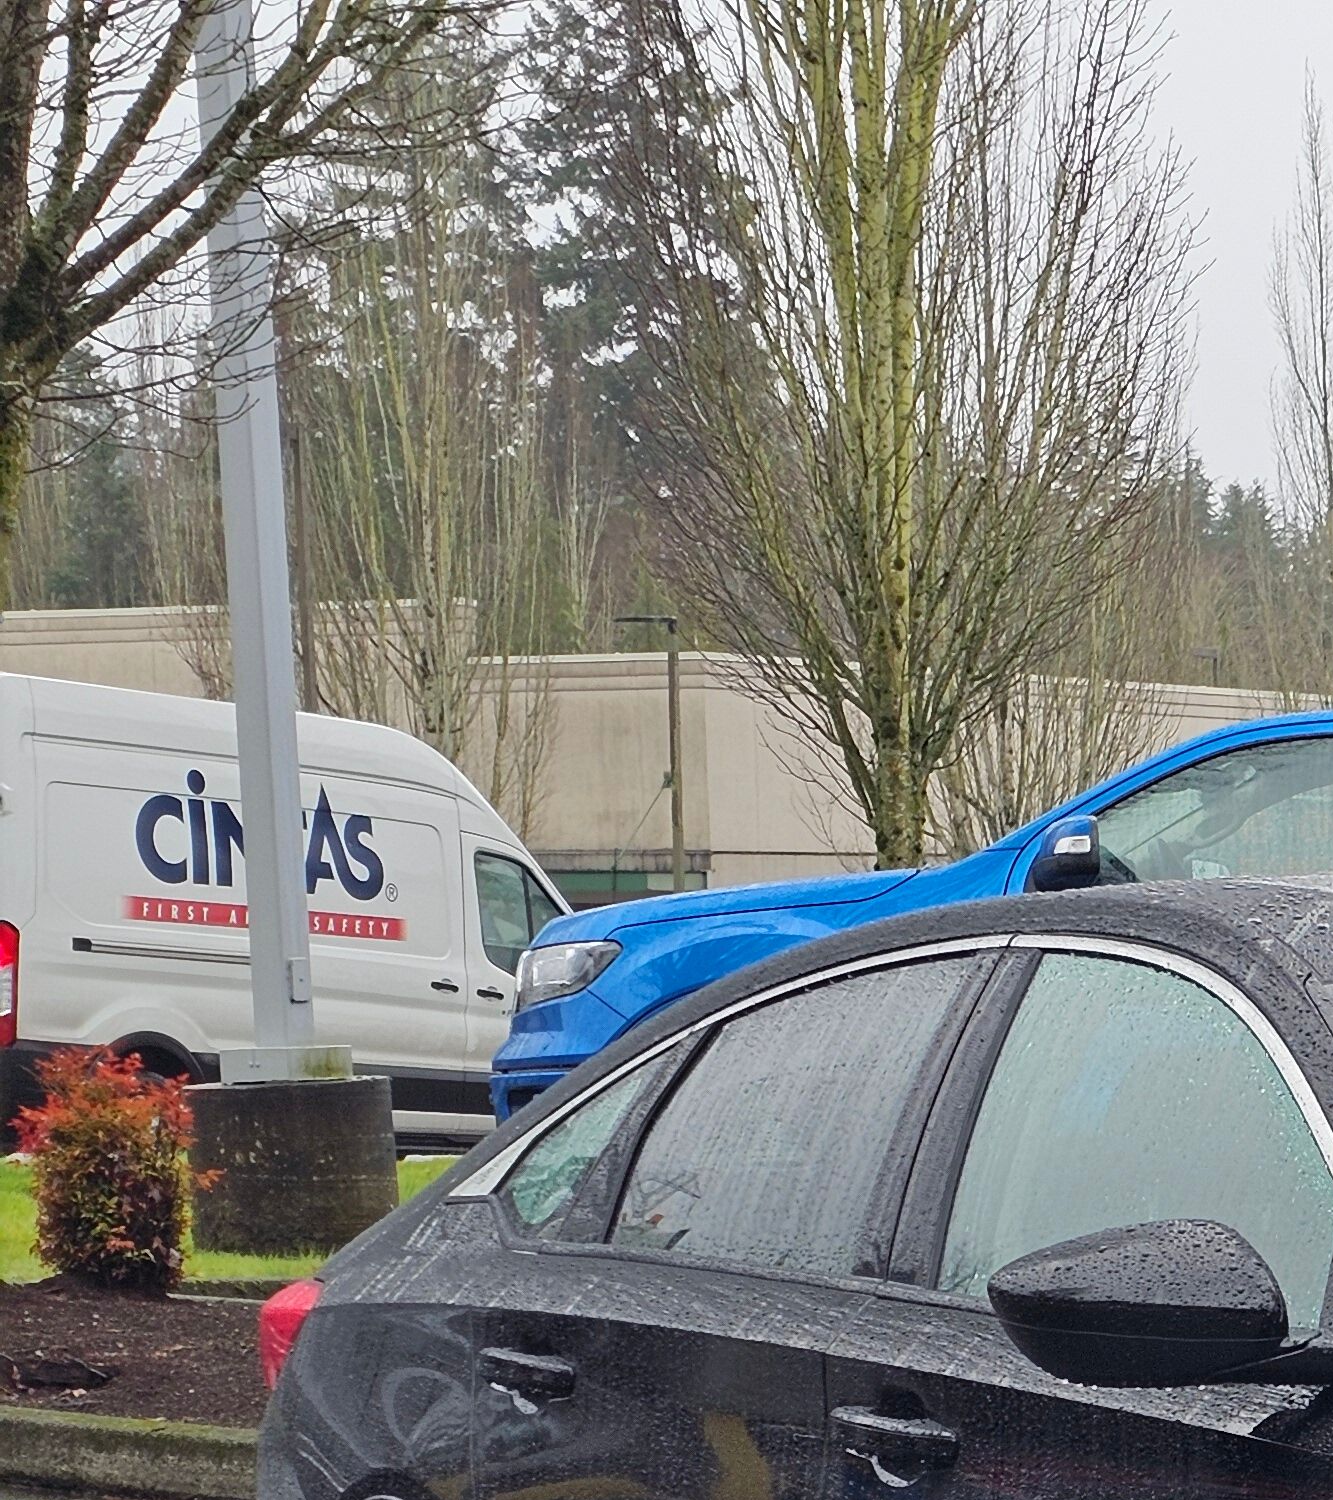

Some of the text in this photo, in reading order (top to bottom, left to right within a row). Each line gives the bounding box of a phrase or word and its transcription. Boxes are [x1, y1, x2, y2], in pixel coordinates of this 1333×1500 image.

[135, 769, 385, 901] CINAS
[143, 901, 209, 922] FIRST
[313, 916, 390, 936] SAFETY
